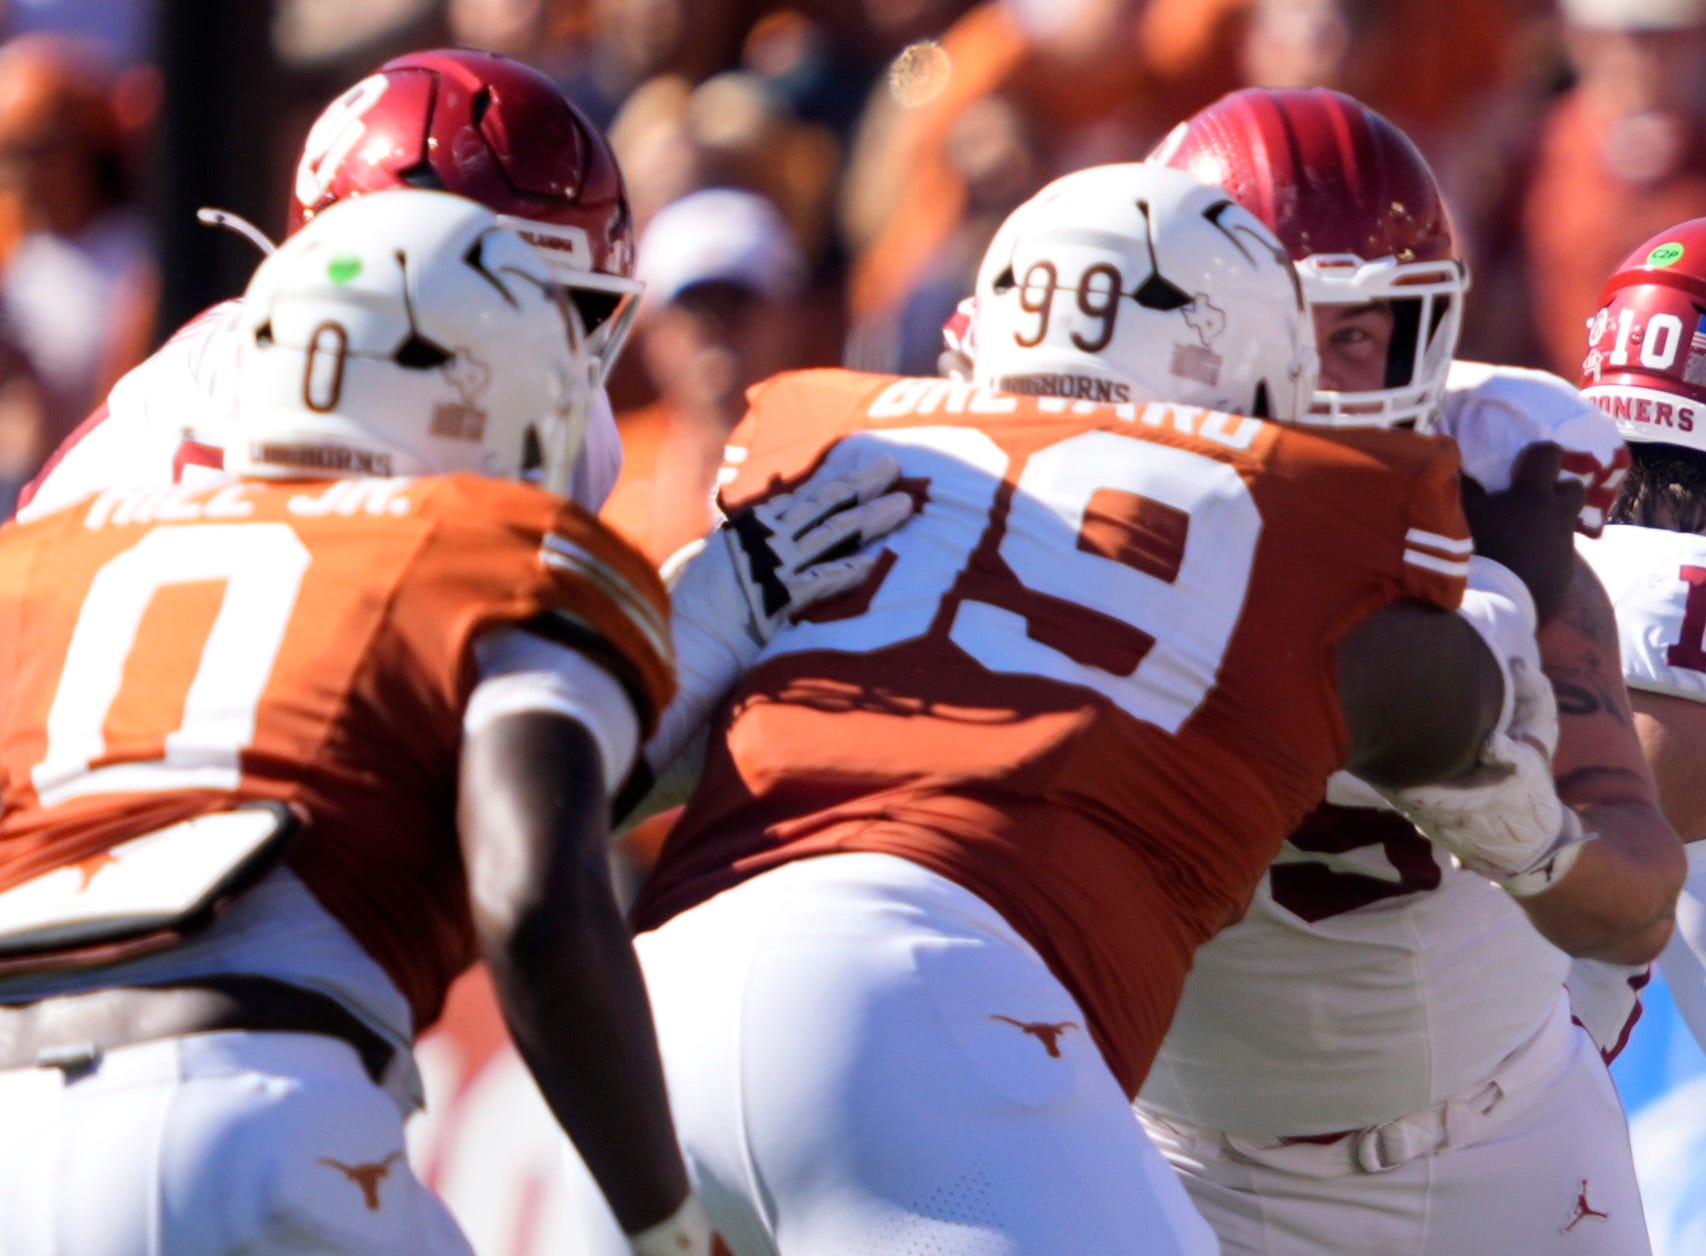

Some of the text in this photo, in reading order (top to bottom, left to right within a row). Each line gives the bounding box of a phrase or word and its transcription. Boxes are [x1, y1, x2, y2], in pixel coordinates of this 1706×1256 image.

[1012, 261, 1123, 353] 99
[1609, 308, 1683, 371] 10
[303, 321, 347, 414] 0
[1589, 395, 1695, 432] ONERS
[757, 425, 1263, 737] 99
[30, 523, 313, 809] 0
